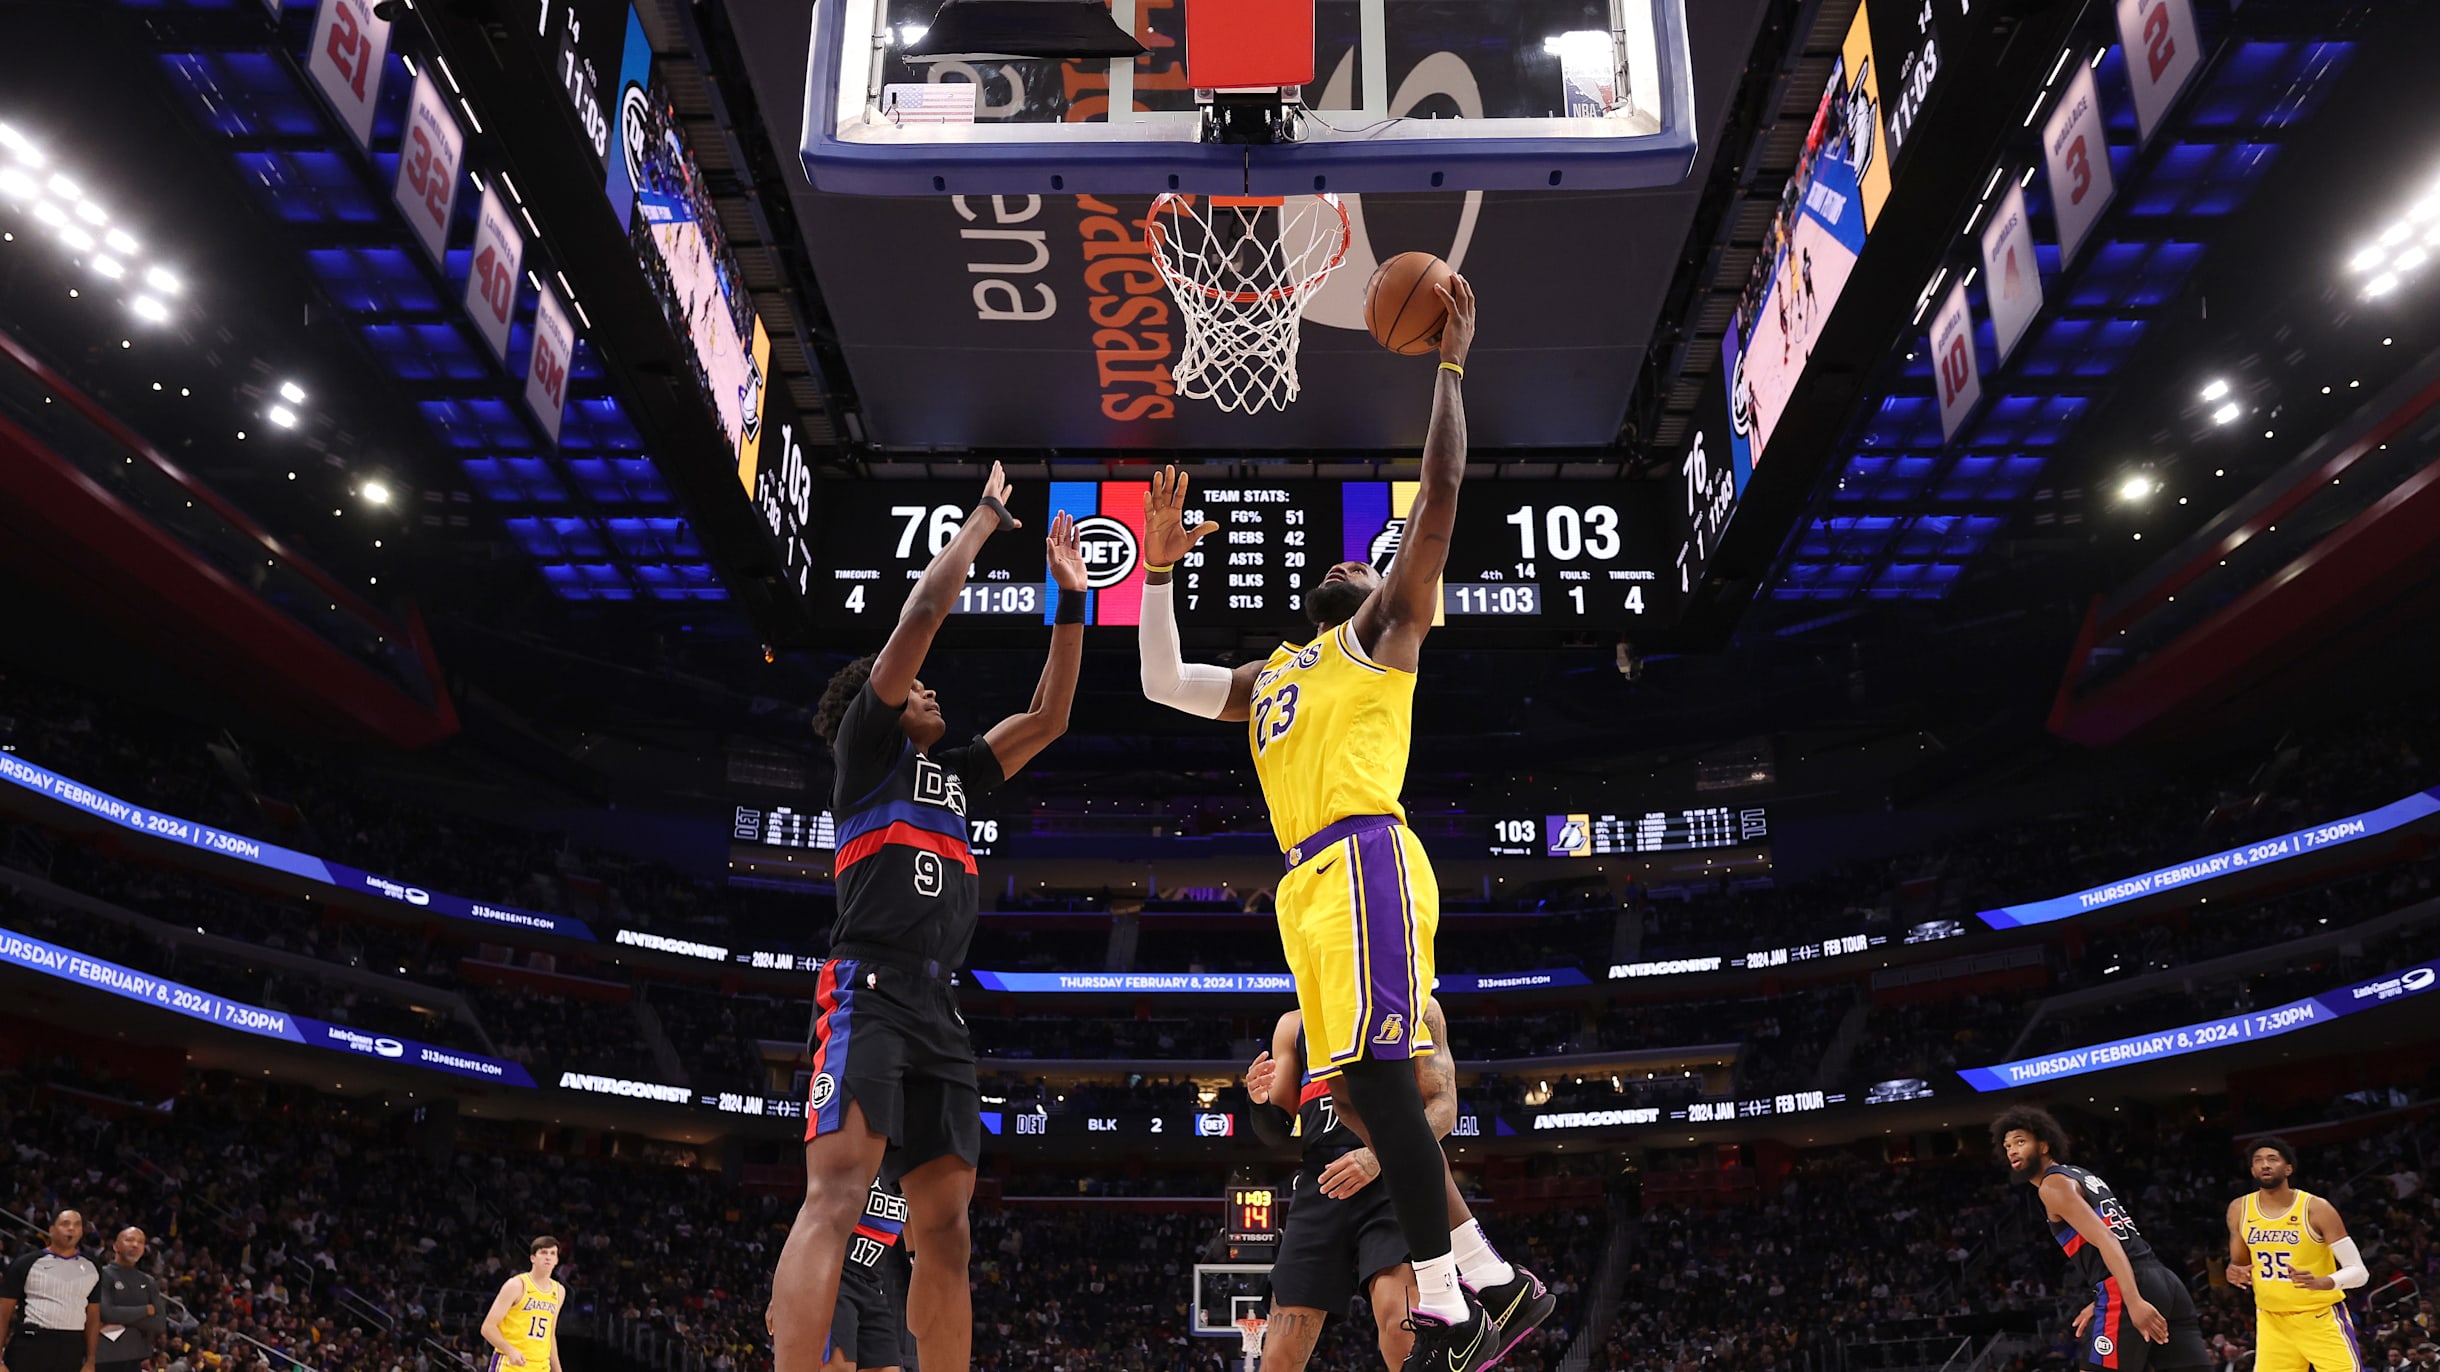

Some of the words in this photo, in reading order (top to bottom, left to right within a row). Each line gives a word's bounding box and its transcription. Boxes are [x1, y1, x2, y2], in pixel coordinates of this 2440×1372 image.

[568, 7, 581, 43] 14
[1918, 0, 1933, 34] 14
[327, 1, 371, 104] 21
[2143, 1, 2176, 85] 2
[565, 50, 606, 157] 11:03
[1891, 39, 1937, 148] 11:03
[1573, 103, 1597, 117] NBA
[419, 102, 454, 166] HAMILTON
[2054, 96, 2088, 156] WALLACE
[406, 125, 450, 231] 32
[2066, 135, 2092, 206] 3
[475, 245, 512, 325] 40
[1941, 334, 1969, 409] 10
[782, 424, 811, 526] 103
[1683, 430, 1707, 517] 76
[759, 474, 782, 537] 11:03
[1203, 490, 1240, 502] TEAM
[1244, 490, 1290, 502] STATS:
[1708, 470, 1733, 534] 11:03
[891, 504, 964, 559] 76
[1184, 510, 1204, 525] 38
[1231, 510, 1262, 523] FG%
[1286, 510, 1304, 525] 51
[1507, 505, 1621, 560] 103
[1080, 541, 1124, 564] DET
[1229, 531, 1264, 544] REBS
[1284, 531, 1305, 546] 42
[835, 570, 880, 579] TIMEOUTS:
[1184, 552, 1204, 567] 20
[1229, 552, 1264, 565] ASTS
[1285, 552, 1305, 567] 20
[1480, 570, 1503, 580] 4th
[1515, 563, 1536, 578] 14
[988, 570, 1010, 580] 4th
[1188, 573, 1199, 588] 2
[1229, 573, 1264, 587] BLKS
[1289, 573, 1301, 588] 9
[1560, 571, 1590, 580] FOULS:
[1609, 571, 1655, 580] TIMEOUTS:
[845, 585, 865, 614] 4
[960, 586, 1036, 612] 11:03
[1188, 595, 1199, 610] 7
[1229, 595, 1263, 608] STLS
[1289, 595, 1301, 610] 3
[1456, 587, 1534, 612] 11:03
[1568, 586, 1585, 614] 1
[1624, 586, 1644, 614] 4
[1253, 683, 1300, 760] 23
[54, 780, 130, 820] FEBRUARY
[131, 811, 145, 828] 8,
[148, 816, 188, 839] 2024
[205, 831, 260, 859] 7:30PM
[734, 806, 760, 840] DET
[971, 820, 998, 843] 76
[1494, 820, 1536, 843] 103
[1740, 808, 1766, 840] LAL
[914, 850, 943, 897] 9
[2080, 875, 2153, 909] THURSDAY
[2154, 854, 2231, 889] FEBRUARY
[2232, 851, 2248, 868] 8,
[2249, 840, 2289, 864] 2024
[2305, 819, 2365, 847] 7:30PM
[471, 905, 554, 930] 313PRESENTS.COM
[616, 929, 728, 961] ANTAGONIST
[752, 951, 774, 969] 2024
[775, 954, 793, 970] JAN
[1608, 956, 1721, 979] ANTAGONIST
[1747, 953, 1769, 969] 2024
[1770, 948, 1787, 966] JAN
[1823, 939, 1841, 957] FEB
[1842, 934, 1868, 954] TOUR
[69, 957, 155, 1000] FEBRUARY
[156, 984, 170, 1004] 8,
[172, 990, 210, 1014] 2024
[225, 1005, 284, 1033] 7:30PM
[1059, 976, 1122, 989] THURSDAY
[1126, 977, 1189, 989] FEBRUARY
[1190, 977, 1201, 990] 8,
[1203, 977, 1234, 989] 2024
[1247, 977, 1290, 989] 7:30PM
[1477, 974, 1551, 988] 313PRESENTS.COM
[2009, 1052, 2089, 1083] THURSDAY
[2091, 1035, 2175, 1066] FEBRUARY
[2177, 1031, 2194, 1049] 8,
[2195, 1023, 2239, 1045] 2024
[2256, 1004, 2315, 1034] 7:30PM
[421, 1049, 502, 1076] 313PRESENTS.COM
[559, 1072, 691, 1104] ANTAGONIST
[719, 1092, 742, 1112] 2024
[743, 1097, 762, 1115] JAN
[1016, 1114, 1047, 1134] DET
[1088, 1118, 1117, 1131] BLK
[1150, 1118, 1162, 1132] 2
[1320, 1096, 1338, 1133] 7
[1534, 1108, 1660, 1130] ANTAGONIST
[1689, 1104, 1713, 1122] 2024
[1714, 1102, 1735, 1120] JAN
[1775, 1095, 1795, 1114] FEB
[1795, 1091, 1824, 1111] TOUR
[1451, 1116, 1480, 1136] LAL
[866, 1191, 908, 1223] DET
[1237, 1190, 1272, 1206] 11:03
[1244, 1207, 1268, 1229] 14
[1241, 1233, 1275, 1242] TISSOT
[2247, 1226, 2301, 1246] LAKERS
[850, 1237, 884, 1267] 17
[2256, 1250, 2291, 1280] 35
[521, 1297, 557, 1315] LAKERS
[528, 1315, 549, 1340] 15
